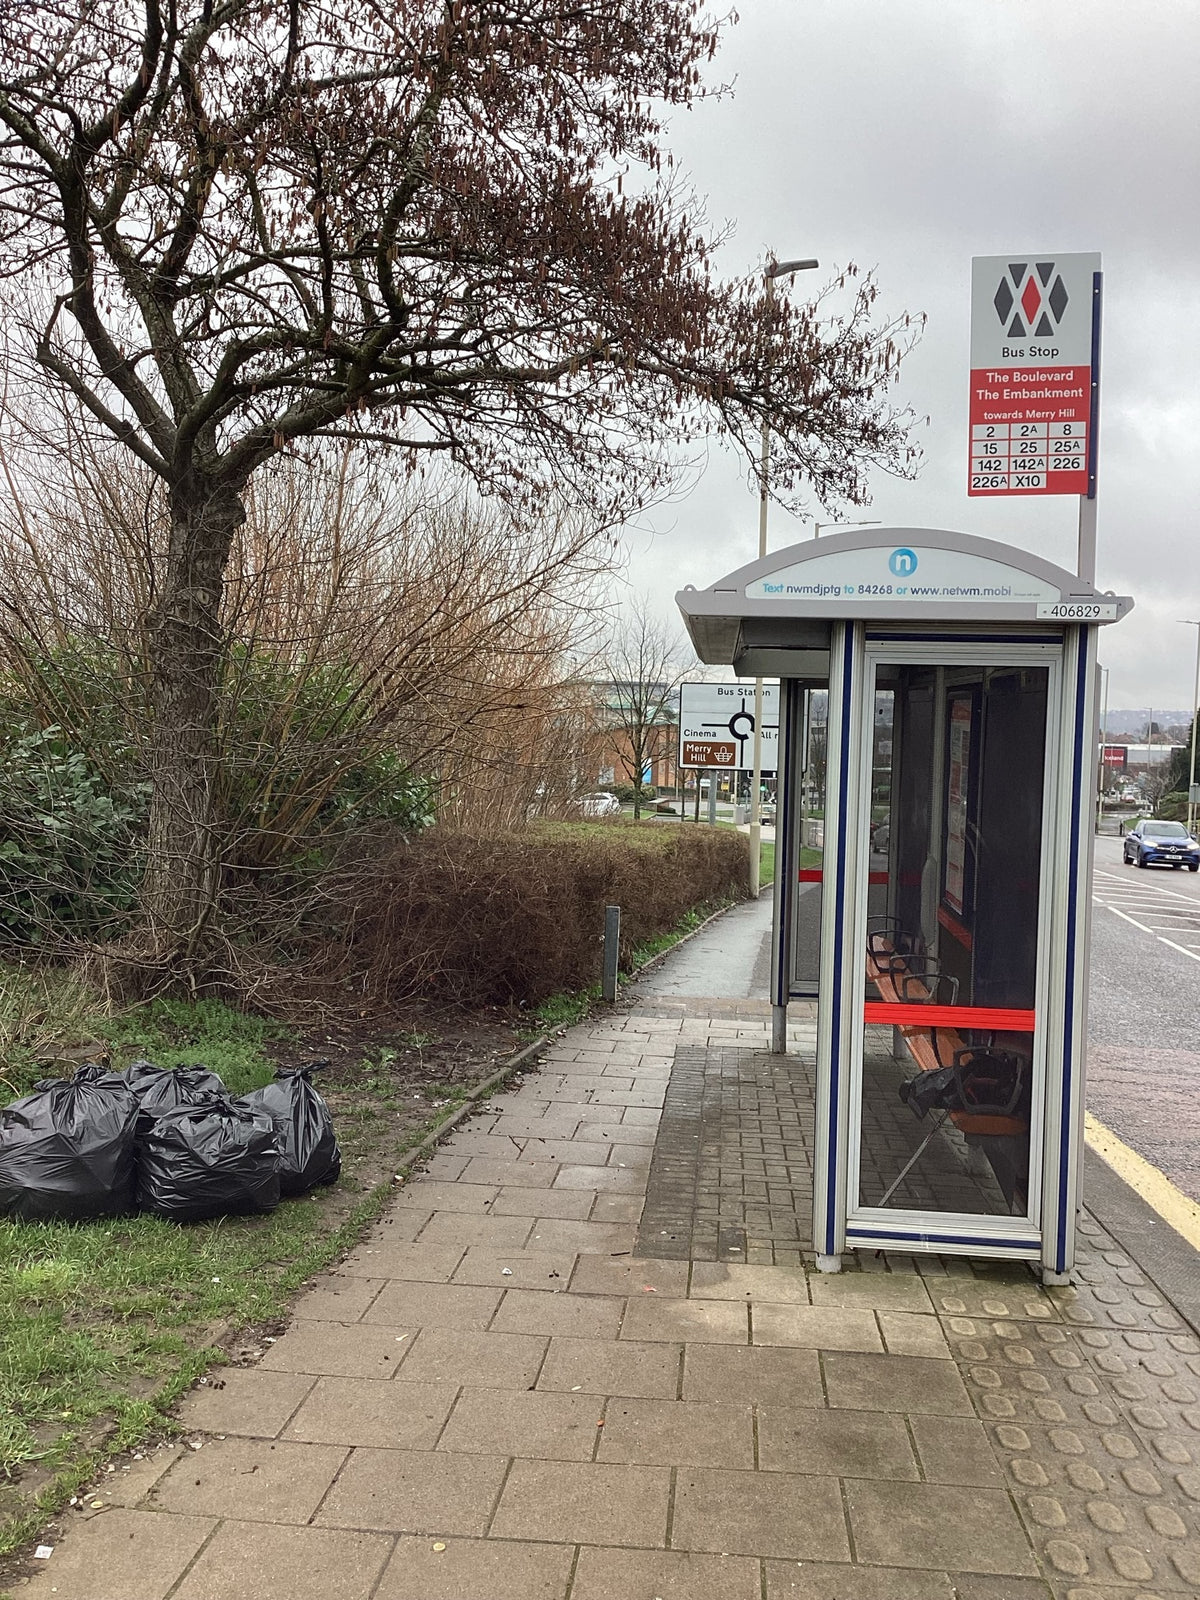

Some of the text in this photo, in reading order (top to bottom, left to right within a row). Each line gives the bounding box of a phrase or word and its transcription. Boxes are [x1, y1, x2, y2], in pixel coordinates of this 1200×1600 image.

[1002, 346, 1059, 359] Bus Stop
[986, 370, 1074, 383] The Boulevard
[976, 387, 1084, 400] The Embankment
[984, 409, 1075, 420] towards Merry Hill
[986, 424, 1072, 438] 2 2A 8
[983, 441, 1080, 454] 15 25 25A
[978, 458, 1080, 471] 142 142A 226
[972, 475, 1040, 488] 226A X10
[762, 583, 1011, 596] Text nwmdjptg to 84268 or www.netwm.mobi
[1050, 605, 1101, 618] 406829
[738, 688, 770, 696] Statn
[684, 729, 717, 737] Cinema
[686, 744, 712, 754] Merry
[690, 754, 706, 762] Hill
